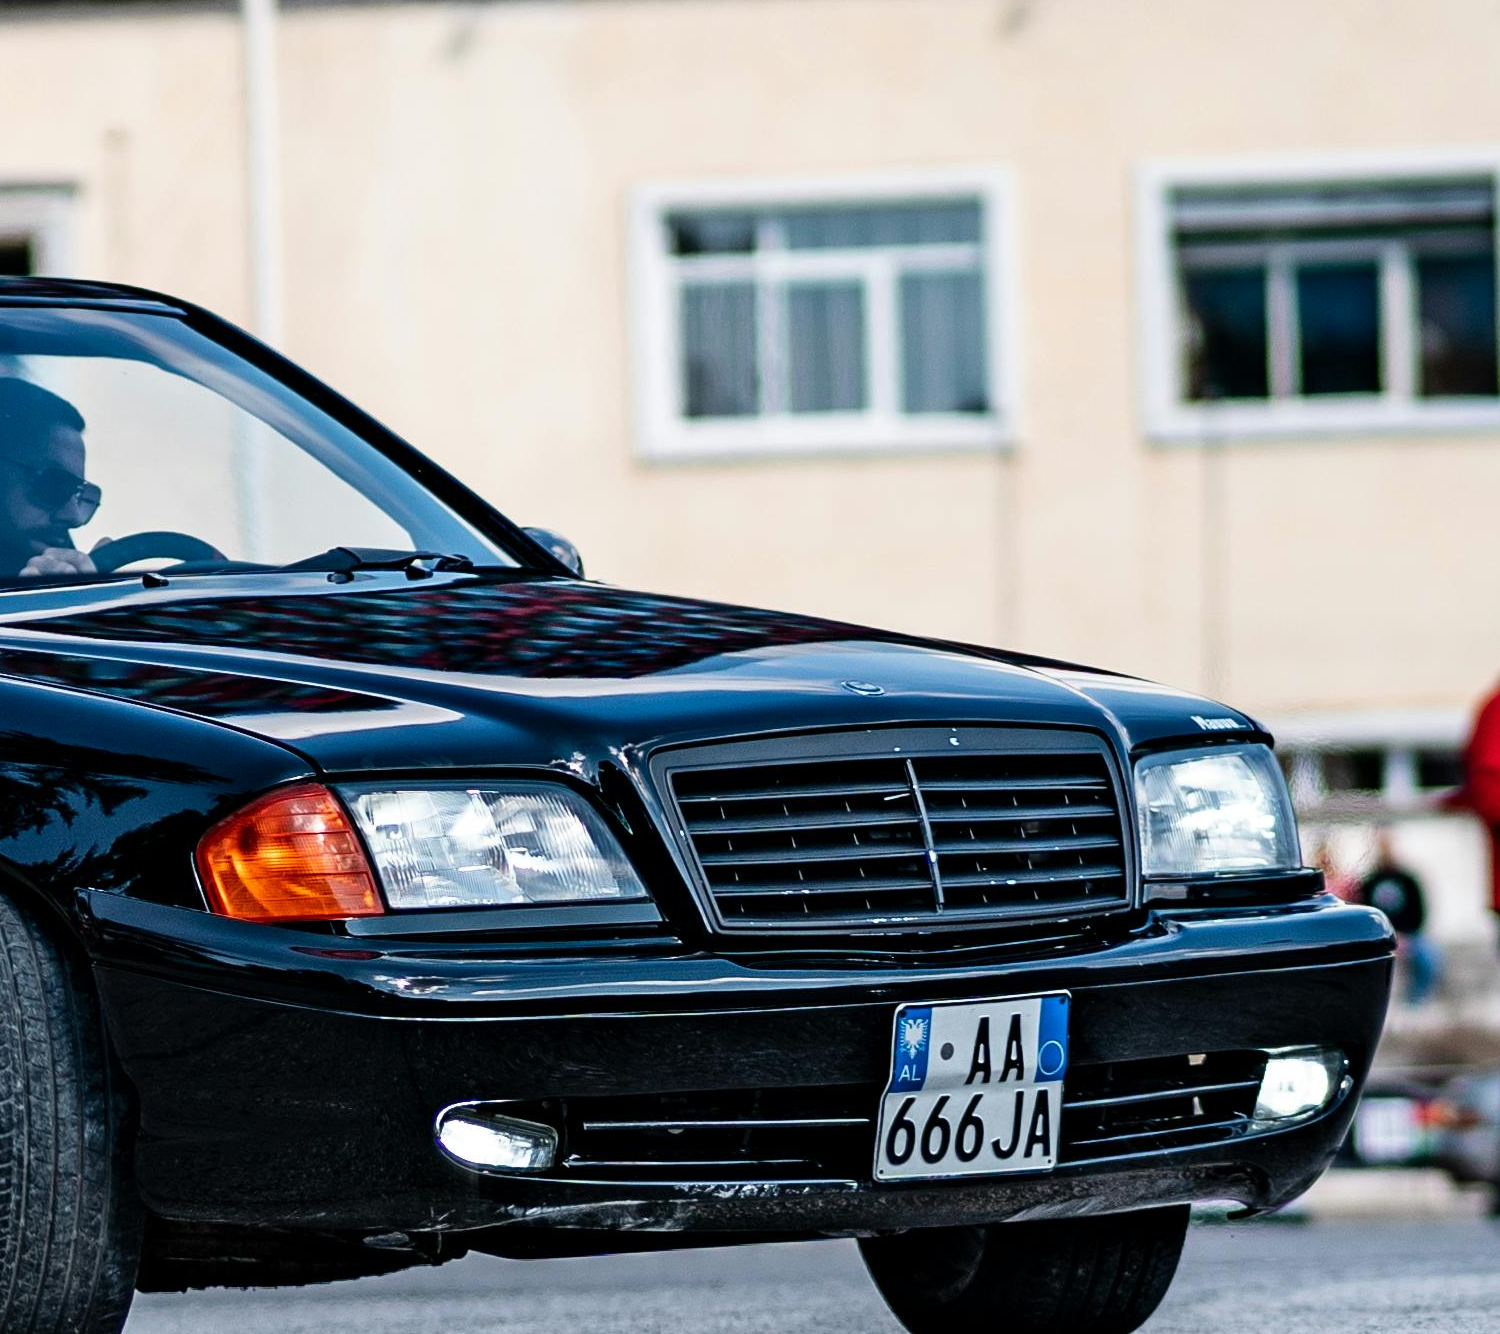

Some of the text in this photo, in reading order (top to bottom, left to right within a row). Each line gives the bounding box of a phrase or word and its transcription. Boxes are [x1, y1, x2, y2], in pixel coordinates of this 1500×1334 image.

[898, 1064, 922, 1083] AL
[964, 1012, 1025, 1085] AA
[885, 1089, 1051, 1166] 666JA
